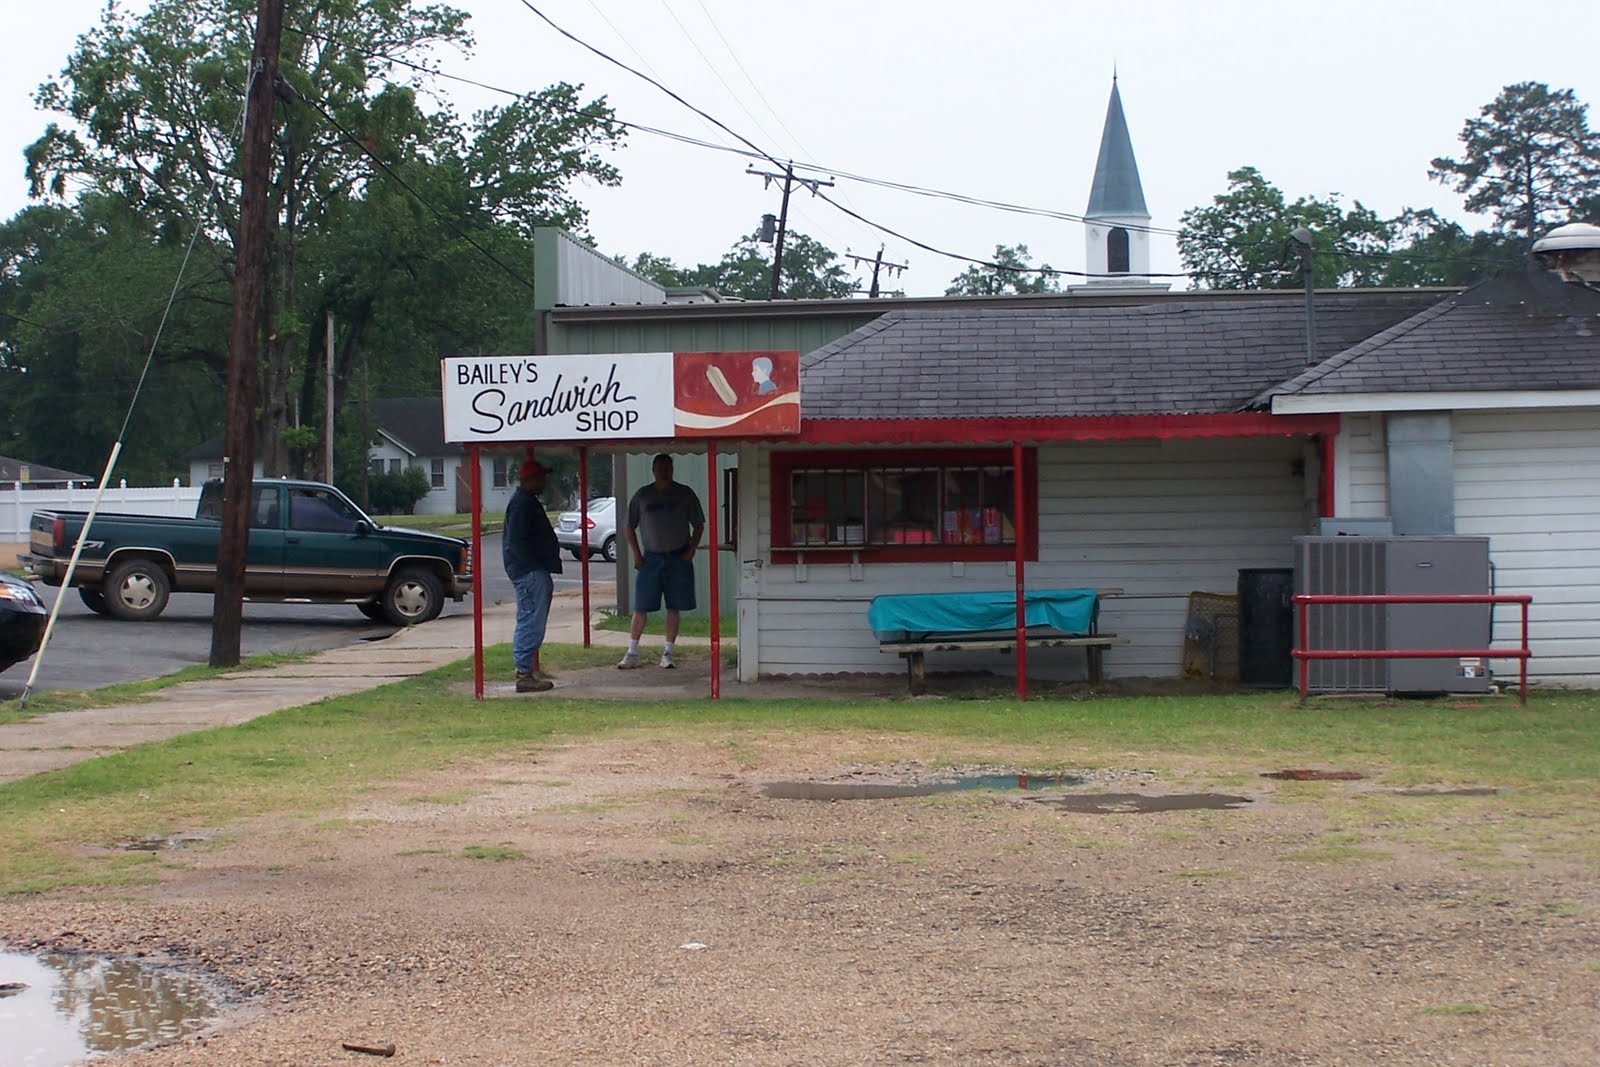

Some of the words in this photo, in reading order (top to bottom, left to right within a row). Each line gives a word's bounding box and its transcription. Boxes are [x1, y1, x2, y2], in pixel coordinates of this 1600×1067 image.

[457, 360, 538, 385] BAILEY'S
[470, 364, 637, 434] Sandwich
[576, 411, 639, 432] SHOP
